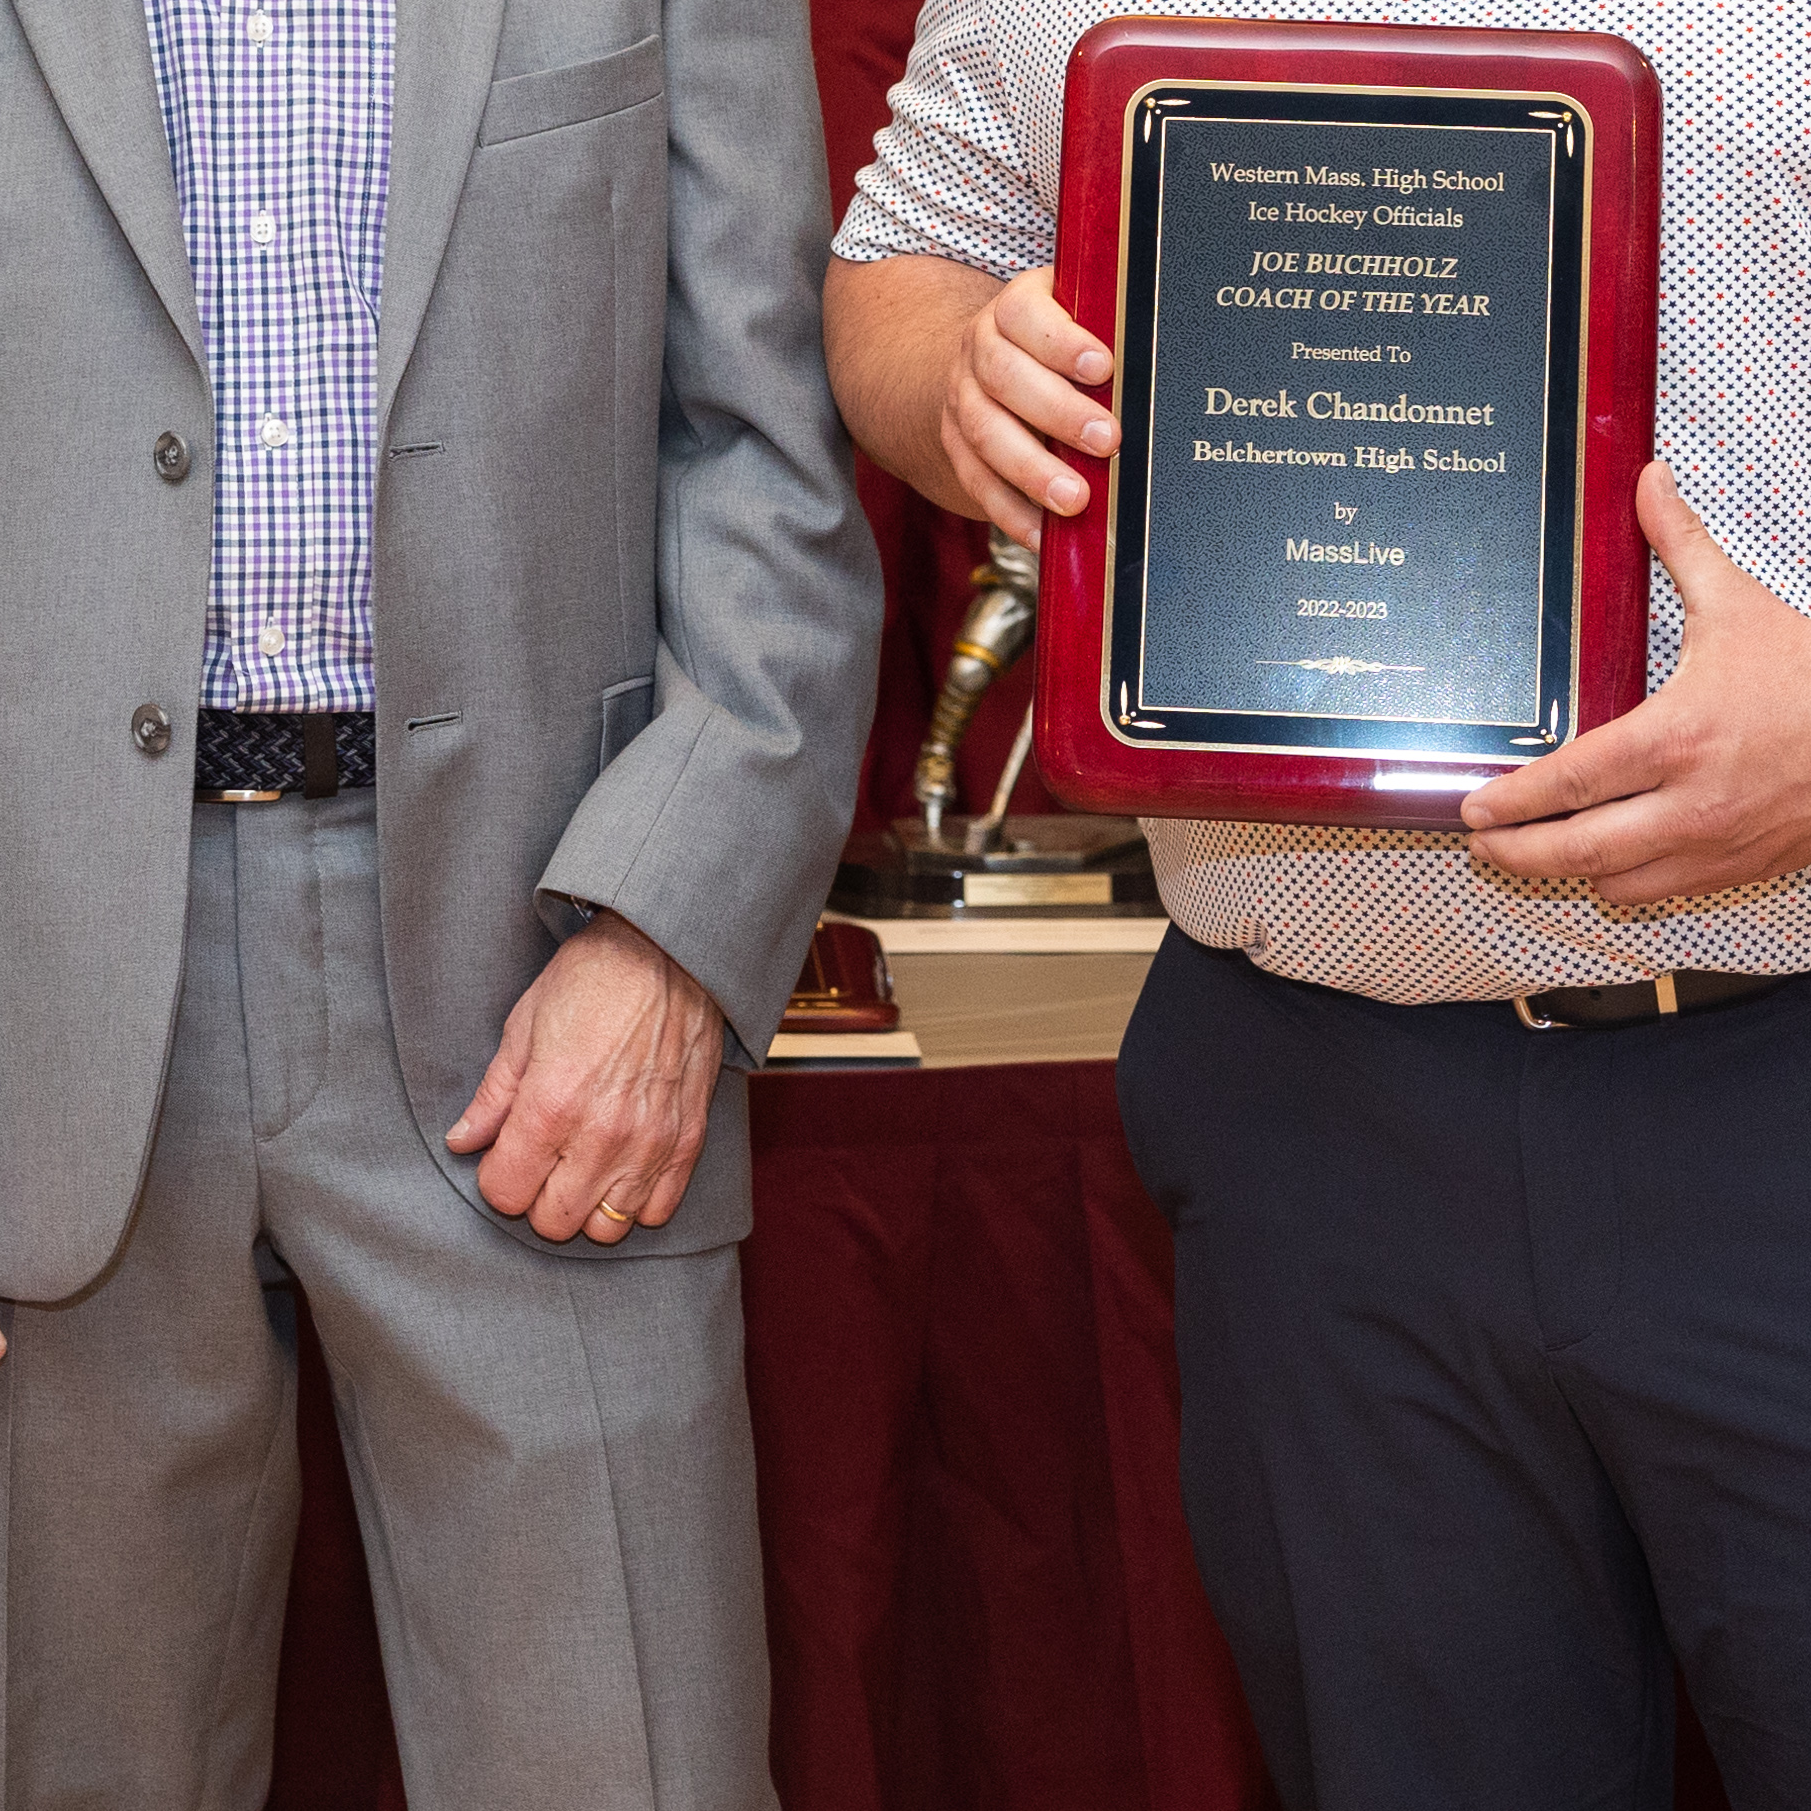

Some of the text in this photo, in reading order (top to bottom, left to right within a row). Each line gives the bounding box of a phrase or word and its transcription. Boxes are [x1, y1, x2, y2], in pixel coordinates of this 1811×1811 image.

[1210, 162, 1505, 195] Western Mass. High School
[1248, 200, 1464, 231] Ice Hockey Officials
[1249, 251, 1459, 279] JOE BUCHHOLZ
[1216, 286, 1490, 316] COACH OF THE YEAR
[1291, 342, 1412, 363] Presented To
[1204, 387, 1495, 426] Derek Chandonnet
[1193, 440, 1506, 474] Belchertown High School
[1333, 501, 1359, 526] by
[1286, 538, 1405, 567] MassLive
[1297, 598, 1389, 621] 2022-2023
